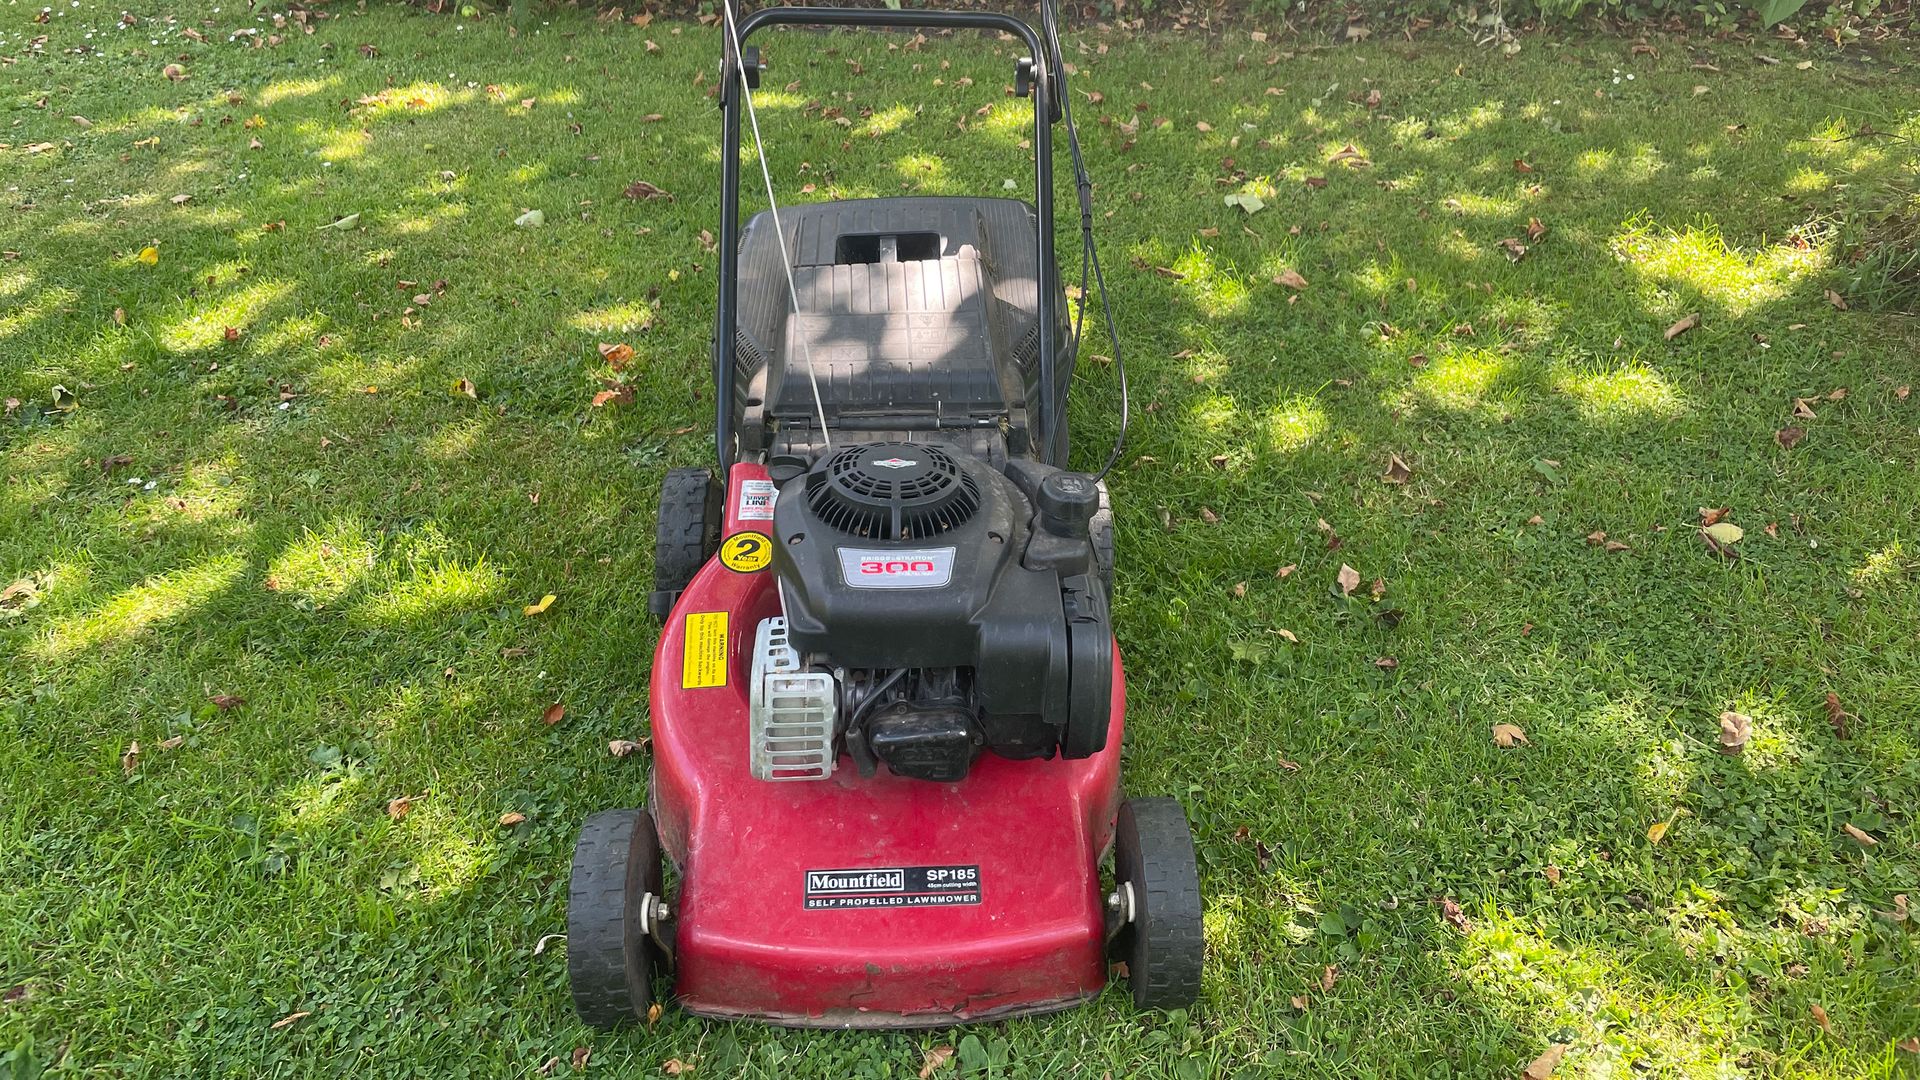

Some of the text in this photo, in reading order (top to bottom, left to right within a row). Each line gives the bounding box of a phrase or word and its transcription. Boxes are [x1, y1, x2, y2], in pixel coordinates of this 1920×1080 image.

[733, 539, 760, 560] 2
[861, 562, 934, 574] 300
[811, 873, 900, 889] Mountfield
[927, 869, 976, 881] SP185
[840, 897, 903, 906] PROPELLED
[907, 895, 977, 904] LAWNMOWER
